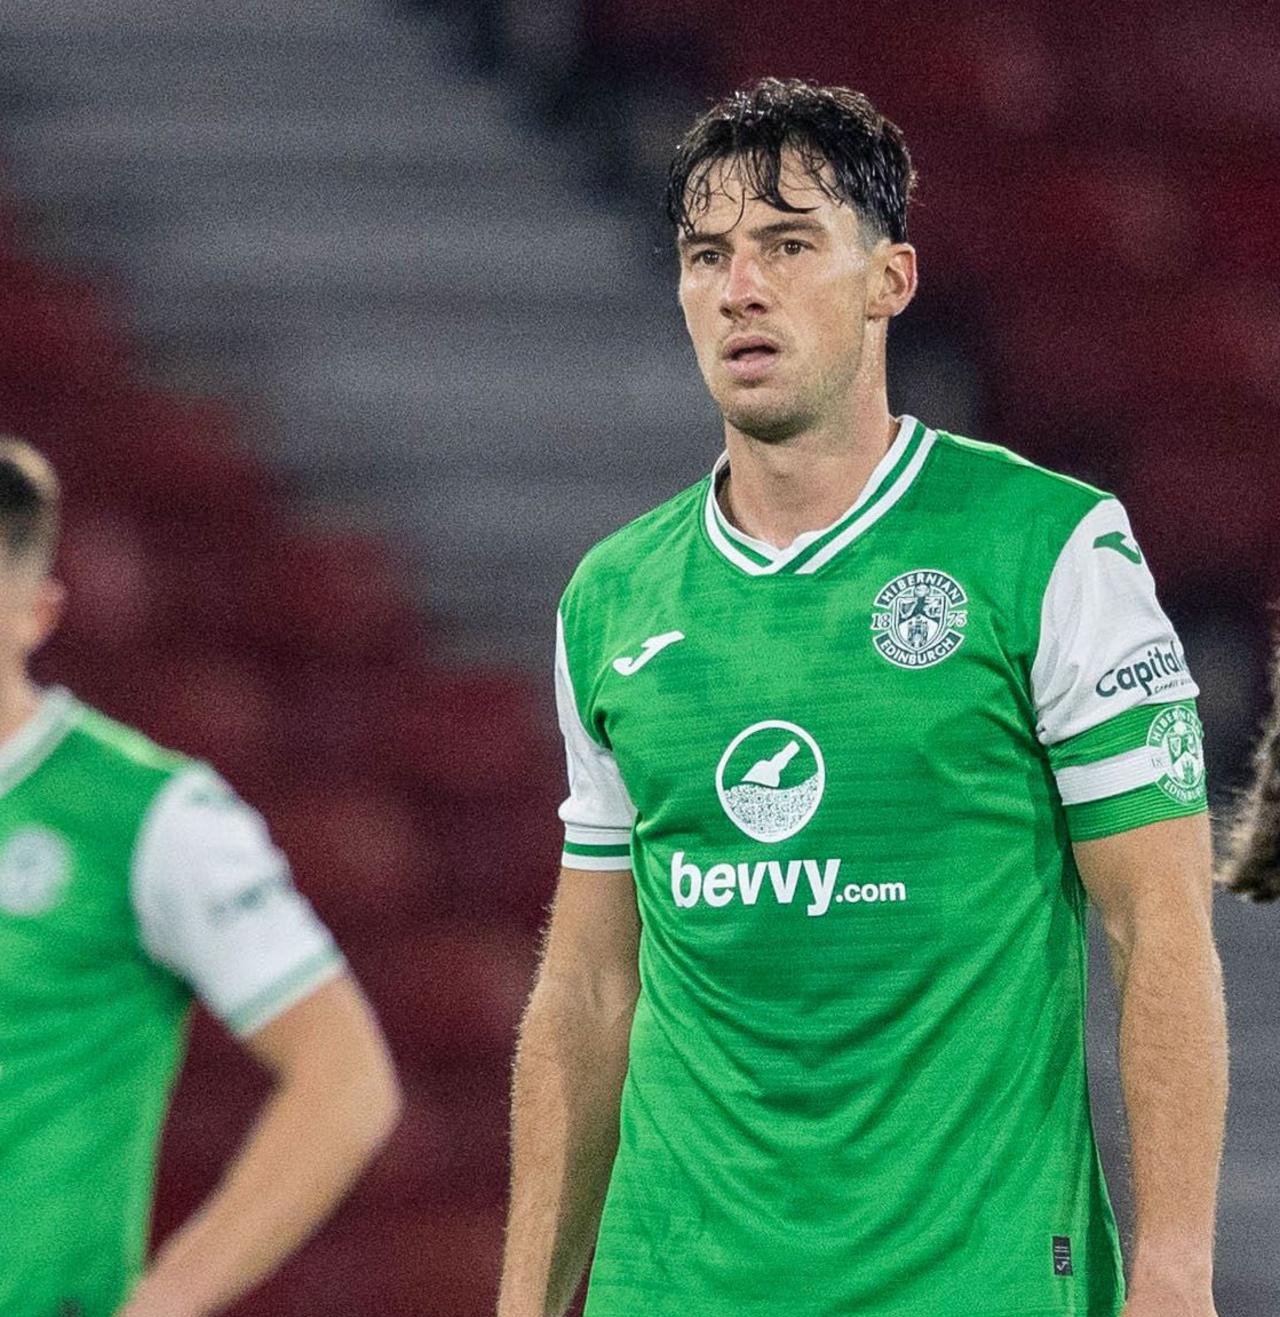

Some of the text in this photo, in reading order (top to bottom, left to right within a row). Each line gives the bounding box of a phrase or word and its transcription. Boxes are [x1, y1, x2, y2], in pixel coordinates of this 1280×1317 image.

[880, 572, 961, 603] HIBERNIAN
[871, 613, 891, 630] 18
[880, 637, 955, 665] EDINBURGH
[1095, 640, 1183, 697] Capital
[671, 851, 907, 916] bevvy.com
